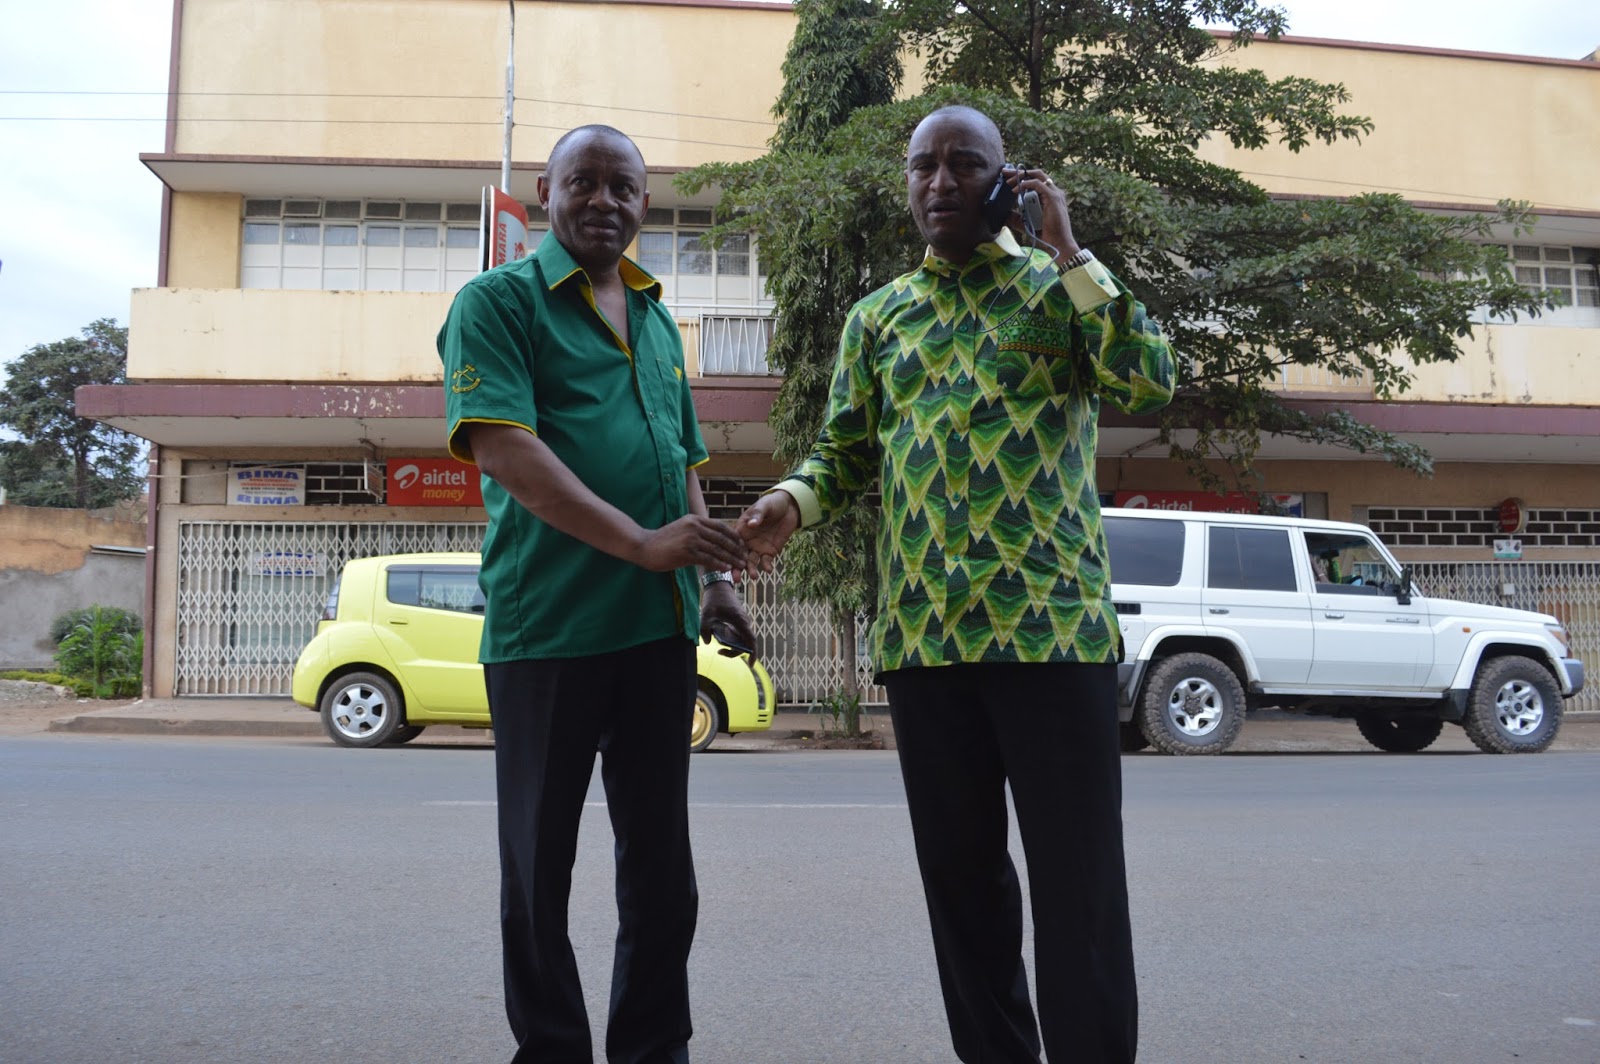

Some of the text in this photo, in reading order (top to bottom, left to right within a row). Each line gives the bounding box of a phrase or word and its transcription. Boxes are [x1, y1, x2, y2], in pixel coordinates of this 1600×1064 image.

[237, 470, 299, 480] BIMA
[422, 469, 467, 486] airtel
[237, 494, 299, 505] BIMA
[422, 489, 465, 502] money
[1152, 499, 1193, 511] airtel
